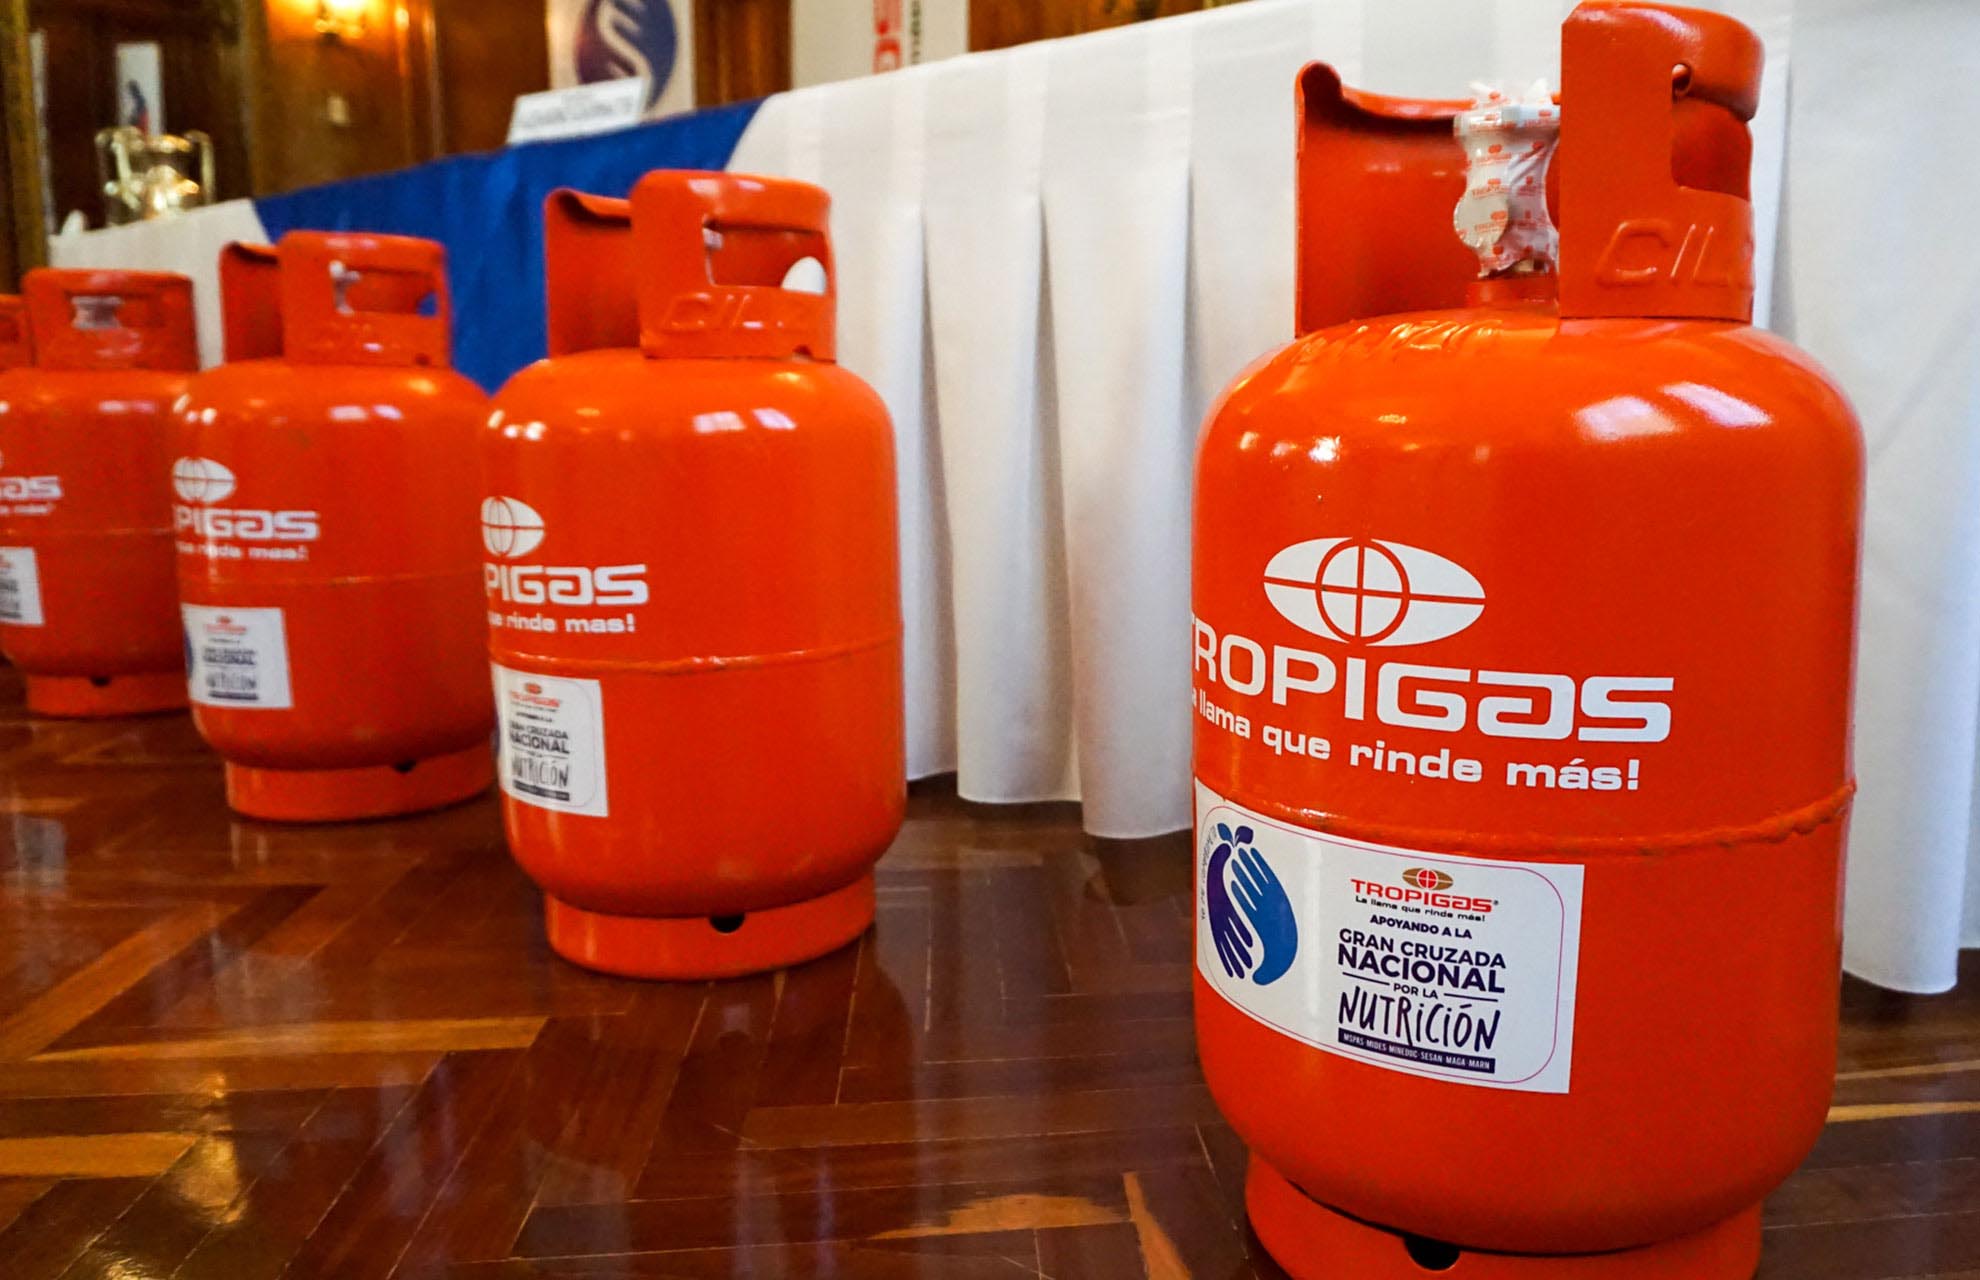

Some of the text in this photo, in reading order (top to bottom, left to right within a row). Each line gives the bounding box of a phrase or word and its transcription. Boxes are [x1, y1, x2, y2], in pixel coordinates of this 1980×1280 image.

[1199, 688, 1251, 740] llama
[1262, 724, 1332, 761] que
[1350, 739, 1483, 783] rinde
[1506, 757, 1641, 791] más!
[1401, 904, 1421, 914] que
[1424, 908, 1454, 919] rinde
[1370, 914, 1473, 940] APOYANDO A LA
[1339, 927, 1507, 970] GRAN CRUZADA
[1337, 943, 1506, 994] NACIONAL
[1393, 982, 1439, 1000] POR LA
[1420, 1052, 1443, 1064] SESAN
